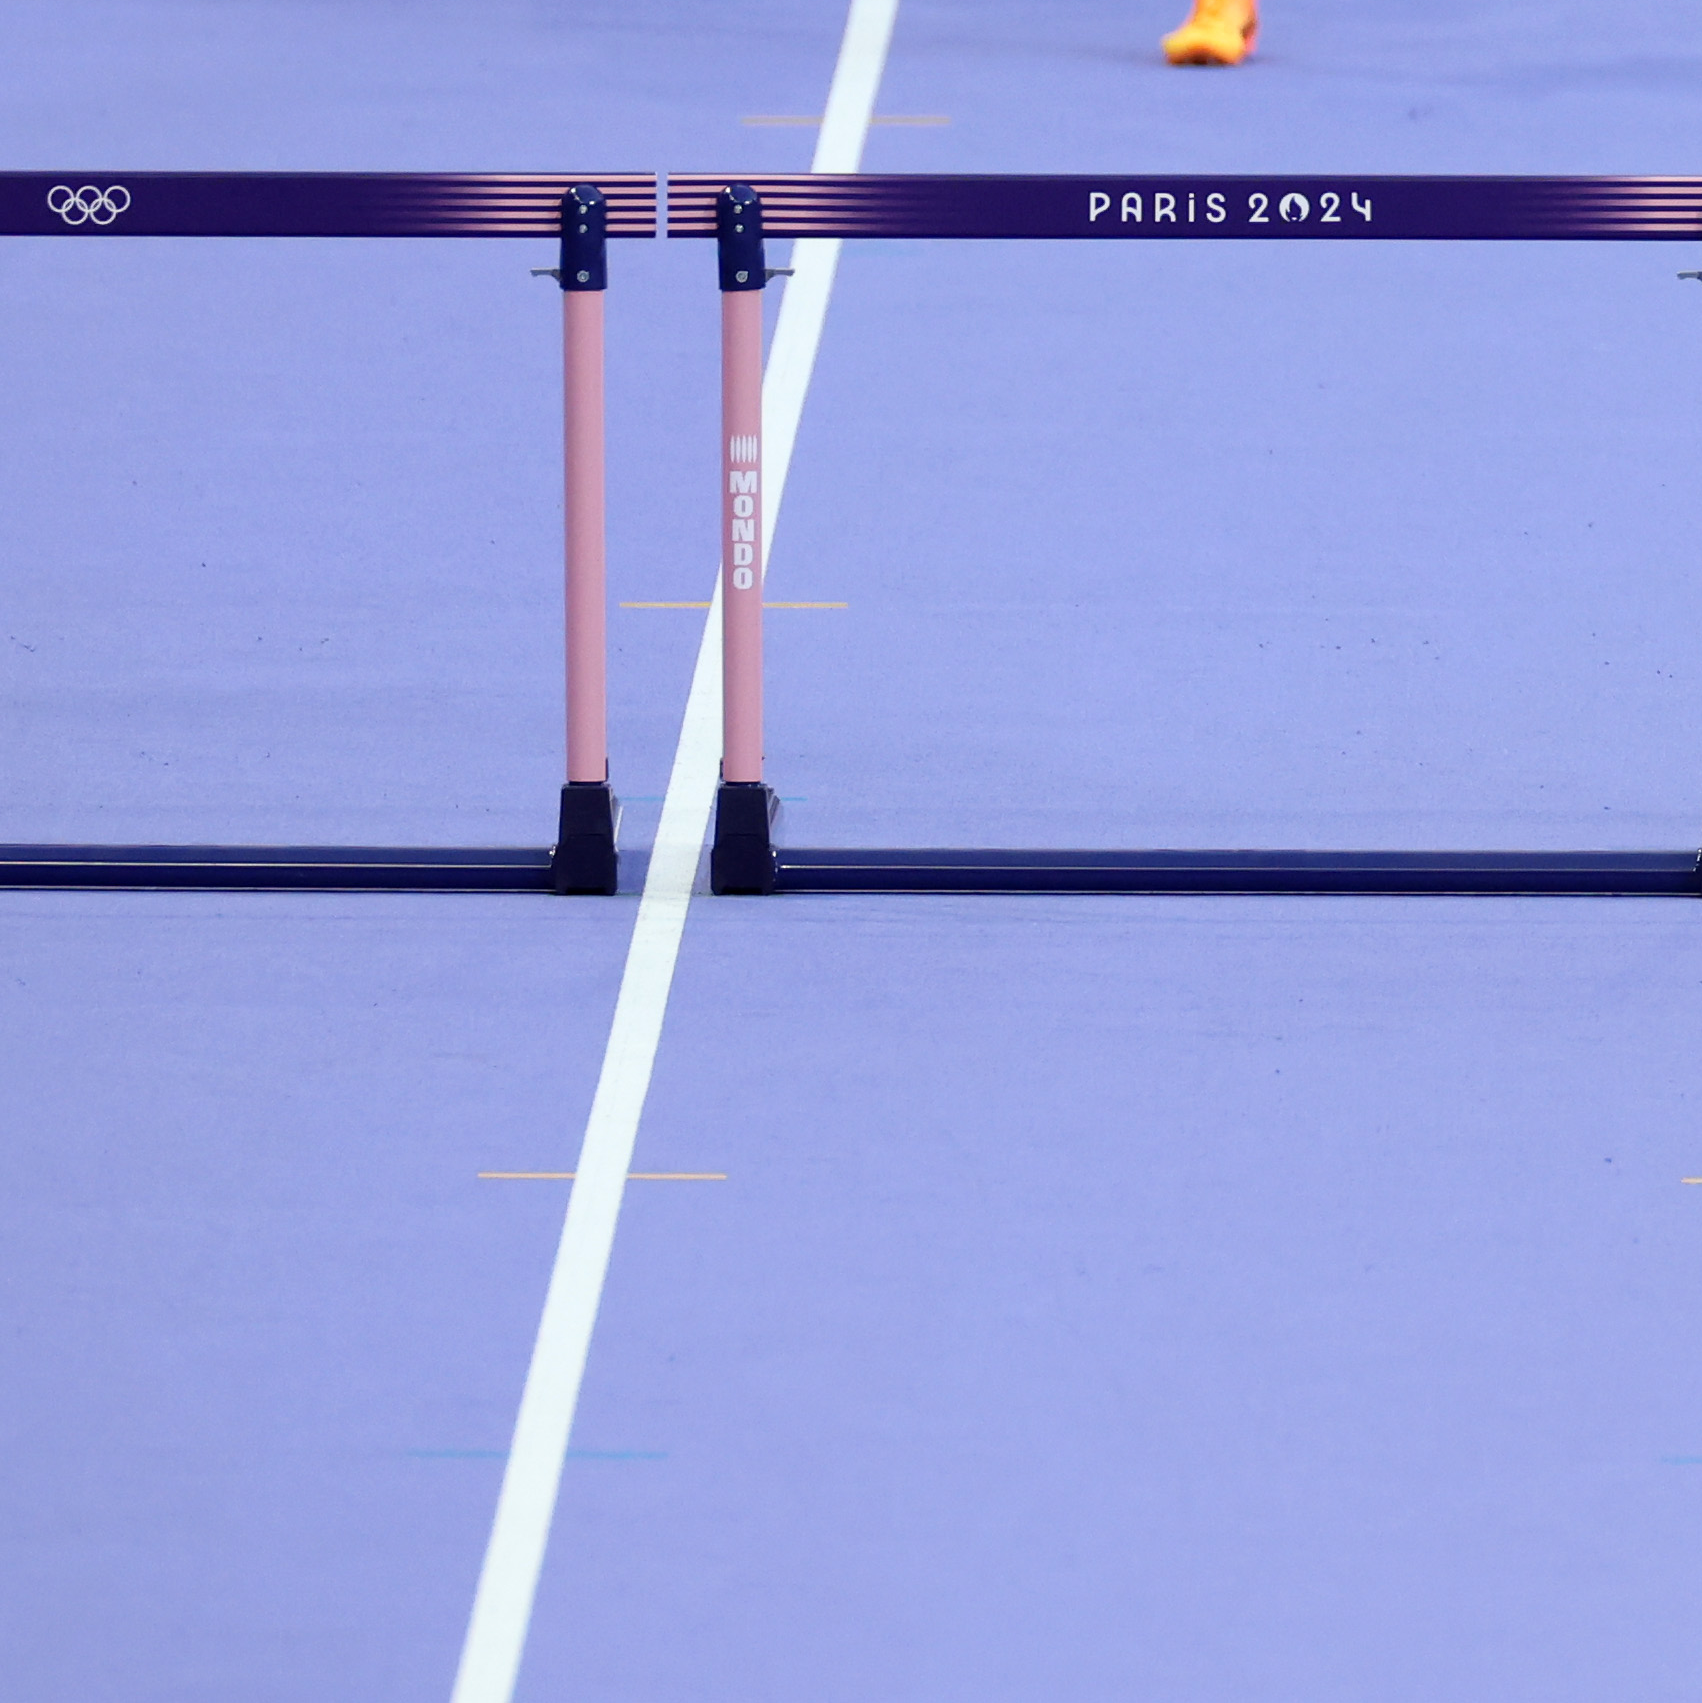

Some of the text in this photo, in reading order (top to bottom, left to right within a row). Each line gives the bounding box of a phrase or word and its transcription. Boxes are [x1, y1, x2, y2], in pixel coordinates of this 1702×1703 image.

[1088, 191, 1372, 224] PARIS 2024
[729, 470, 758, 591] MONDO
